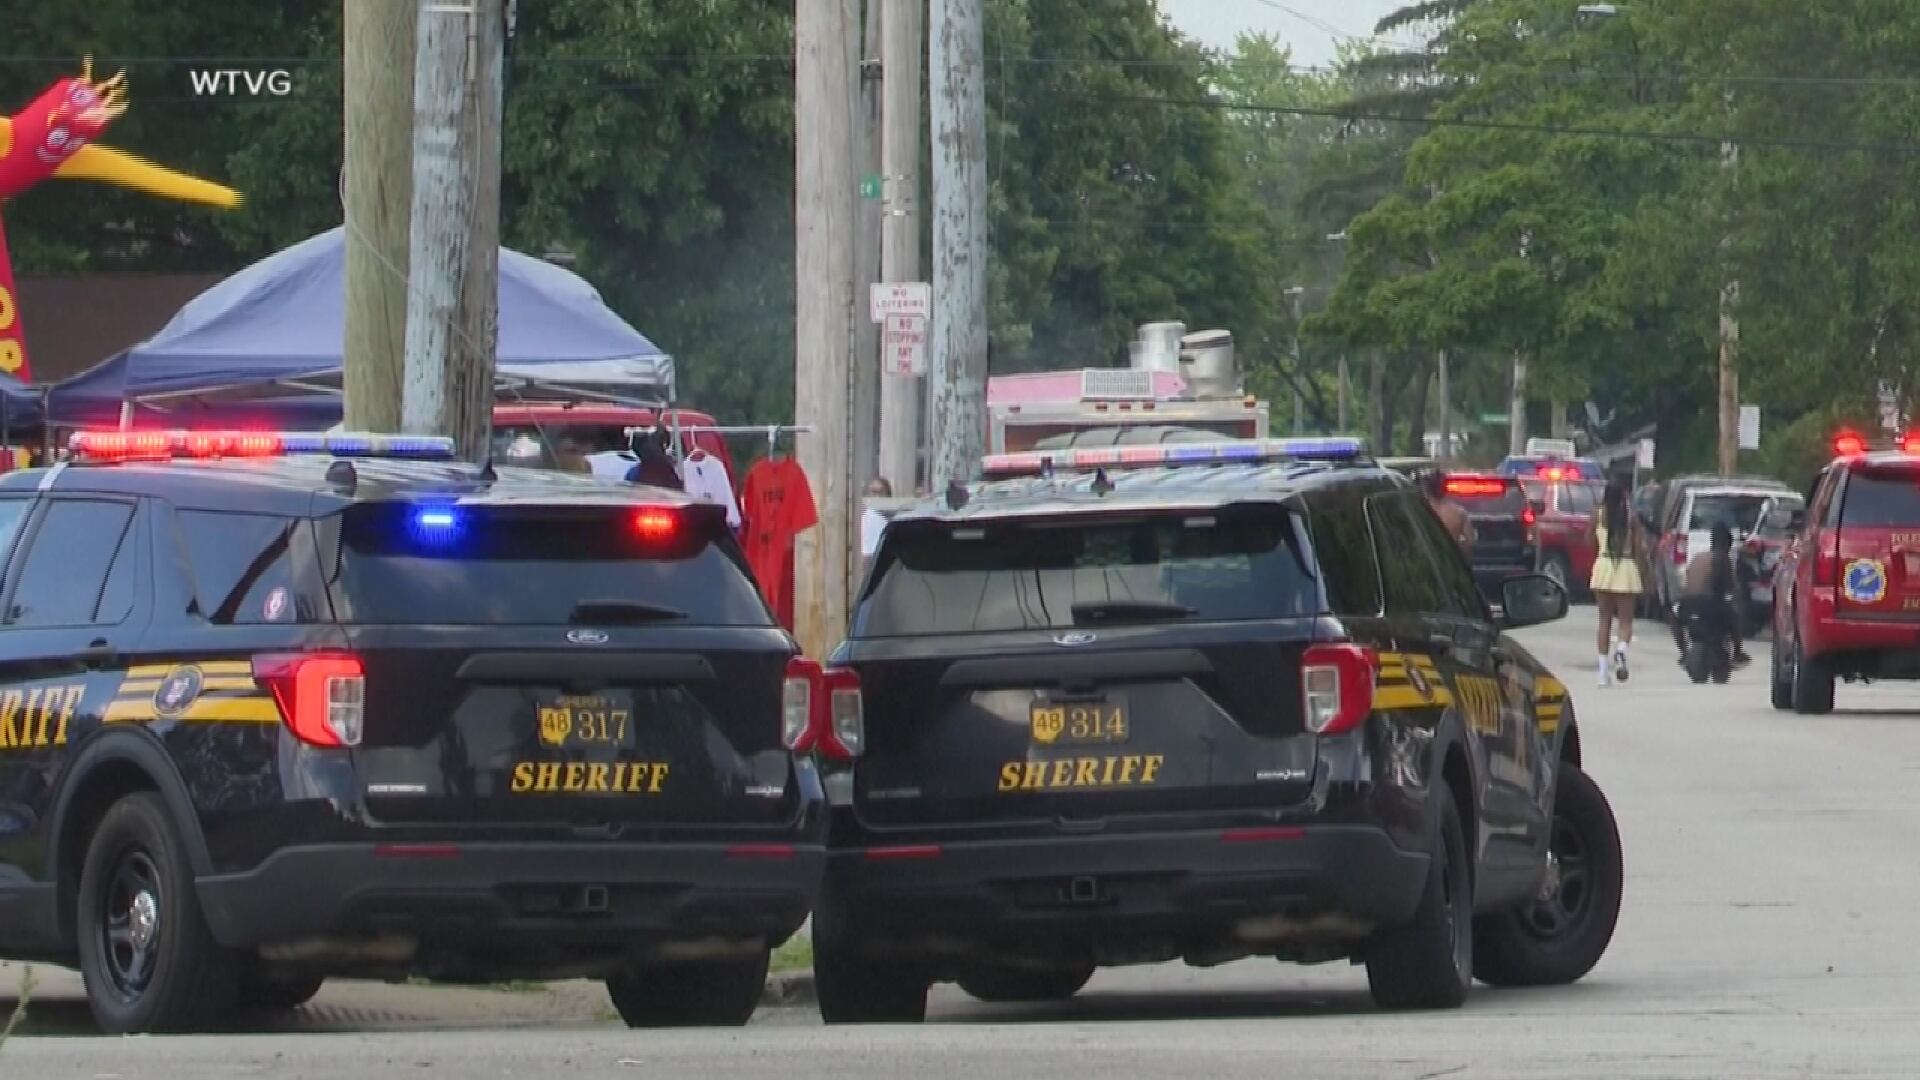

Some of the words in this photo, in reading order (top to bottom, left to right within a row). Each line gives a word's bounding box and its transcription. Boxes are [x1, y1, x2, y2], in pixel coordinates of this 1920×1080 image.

[543, 712, 569, 732] 48
[578, 711, 628, 741] 317
[1036, 711, 1061, 732] 48
[1070, 707, 1126, 738] 314
[511, 762, 669, 792] SHERIFF
[999, 755, 1163, 791] SHERIFF
